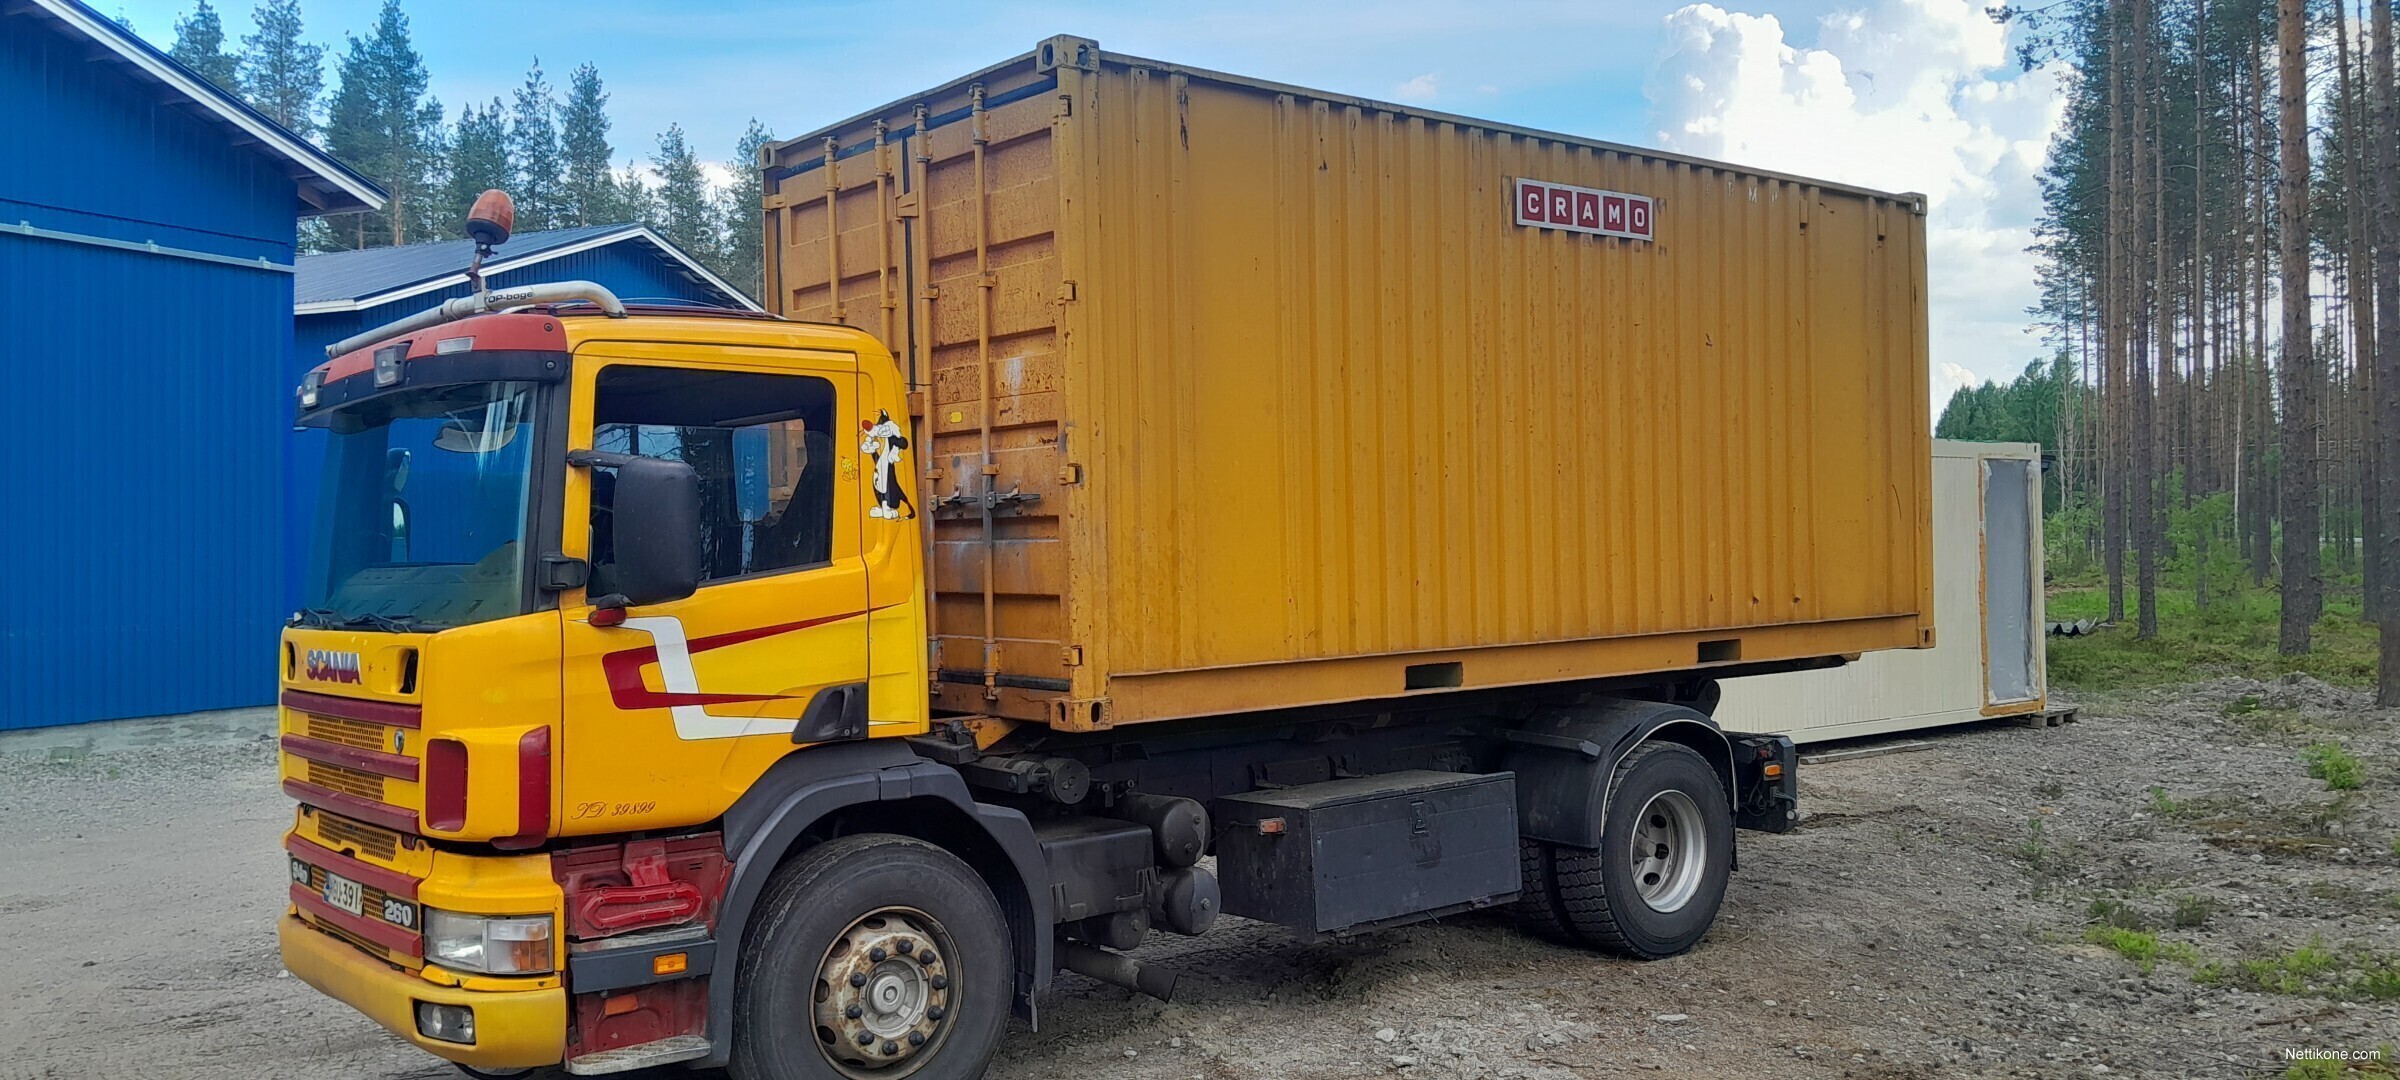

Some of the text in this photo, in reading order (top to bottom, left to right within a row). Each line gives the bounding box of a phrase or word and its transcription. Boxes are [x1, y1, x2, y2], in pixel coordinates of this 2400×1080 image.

[1527, 192, 1645, 228] CRAMO
[307, 649, 362, 685] SCANIA
[612, 801, 656, 816] 39899
[384, 900, 412, 926] 260
